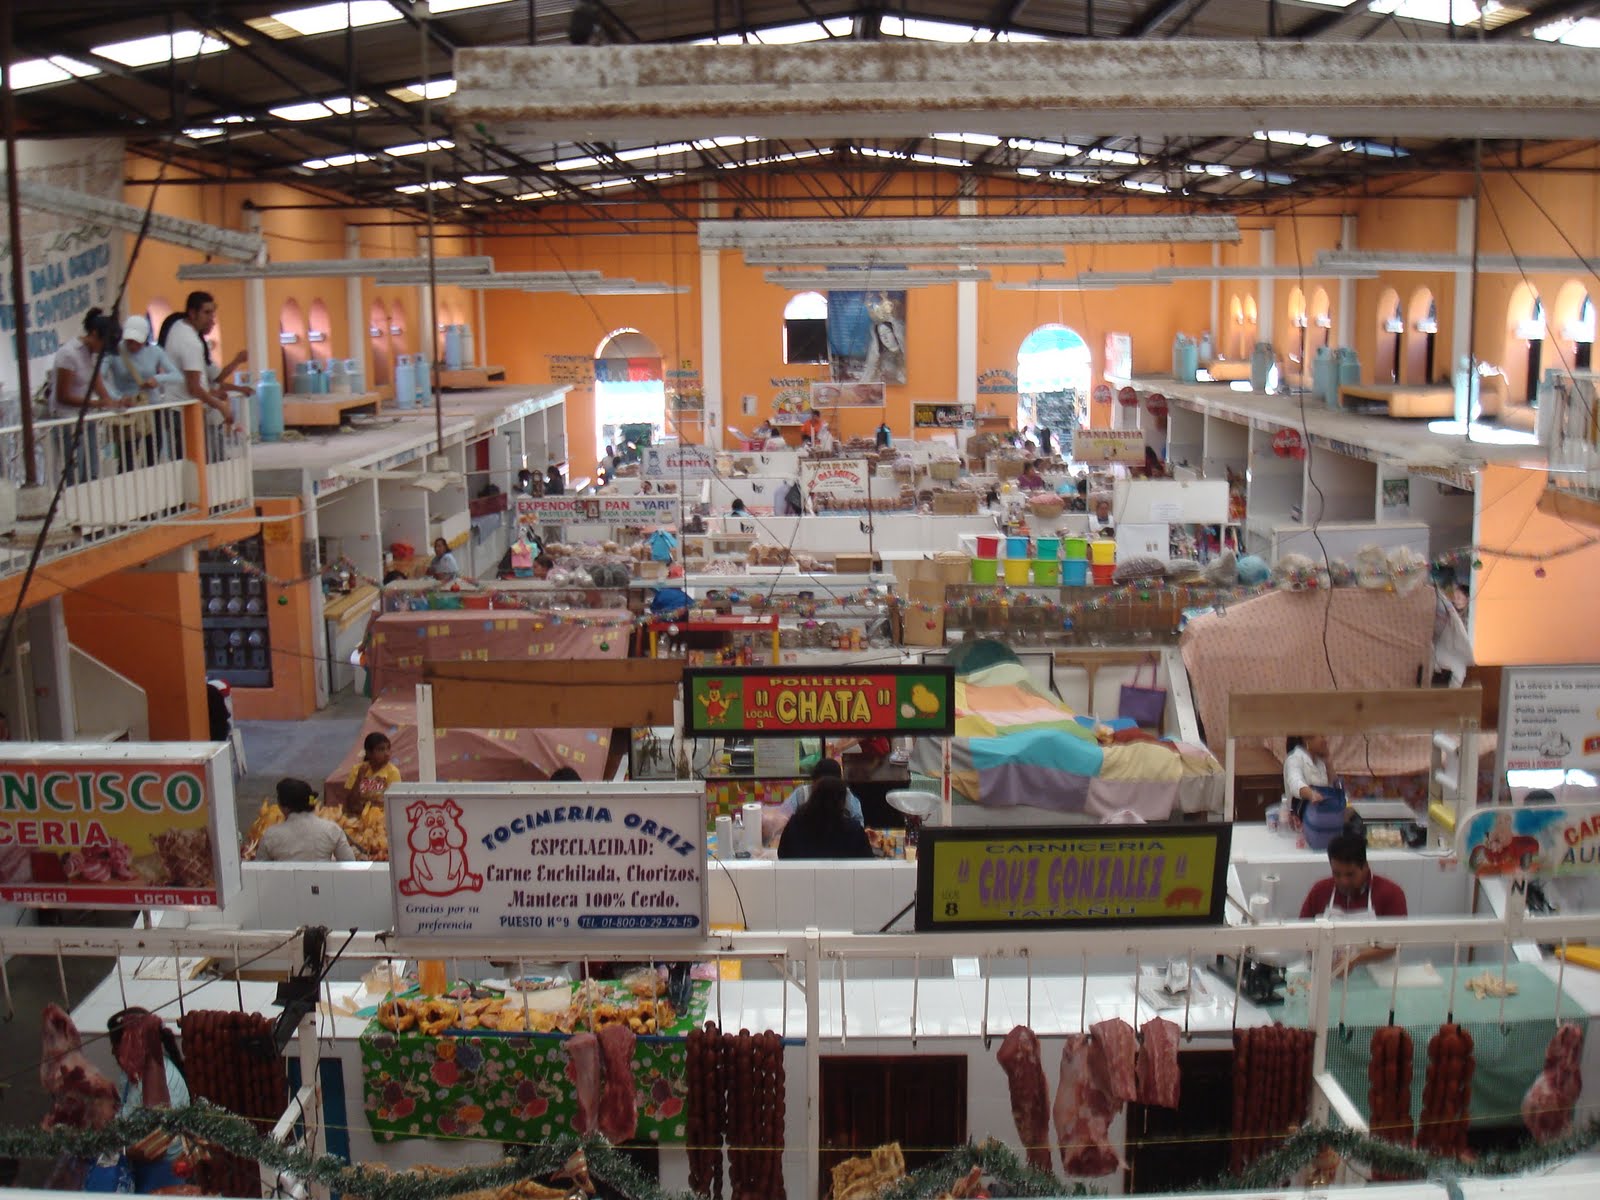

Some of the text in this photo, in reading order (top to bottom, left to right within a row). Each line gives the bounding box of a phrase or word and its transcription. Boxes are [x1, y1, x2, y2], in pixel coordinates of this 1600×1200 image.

[605, 501, 630, 511] PAN
[769, 677, 873, 687] POLLERIA
[775, 689, 872, 724] CHATA
[746, 710, 774, 719] LOCAL
[756, 720, 764, 729] 3
[1, 771, 203, 814] NCISCO
[0, 820, 111, 848] CERIA
[481, 805, 697, 857] TOCINERIA ORTIZ
[530, 837, 654, 856] ESPECIALIDAD:
[985, 841, 1166, 855] CARNICERIA
[486, 863, 532, 882] Carne
[536, 863, 621, 884] Enchilada,
[978, 854, 1167, 908] CRUZ GONZALEZ
[13, 892, 68, 903] PRECIO
[134, 893, 212, 906] LOCAL 10
[507, 889, 680, 909] Manteca 100% Cerdo.
[405, 902, 480, 916] Gracias por su
[944, 901, 959, 917] 8
[416, 919, 473, 934] preferencia
[500, 915, 543, 928] PUESTO
